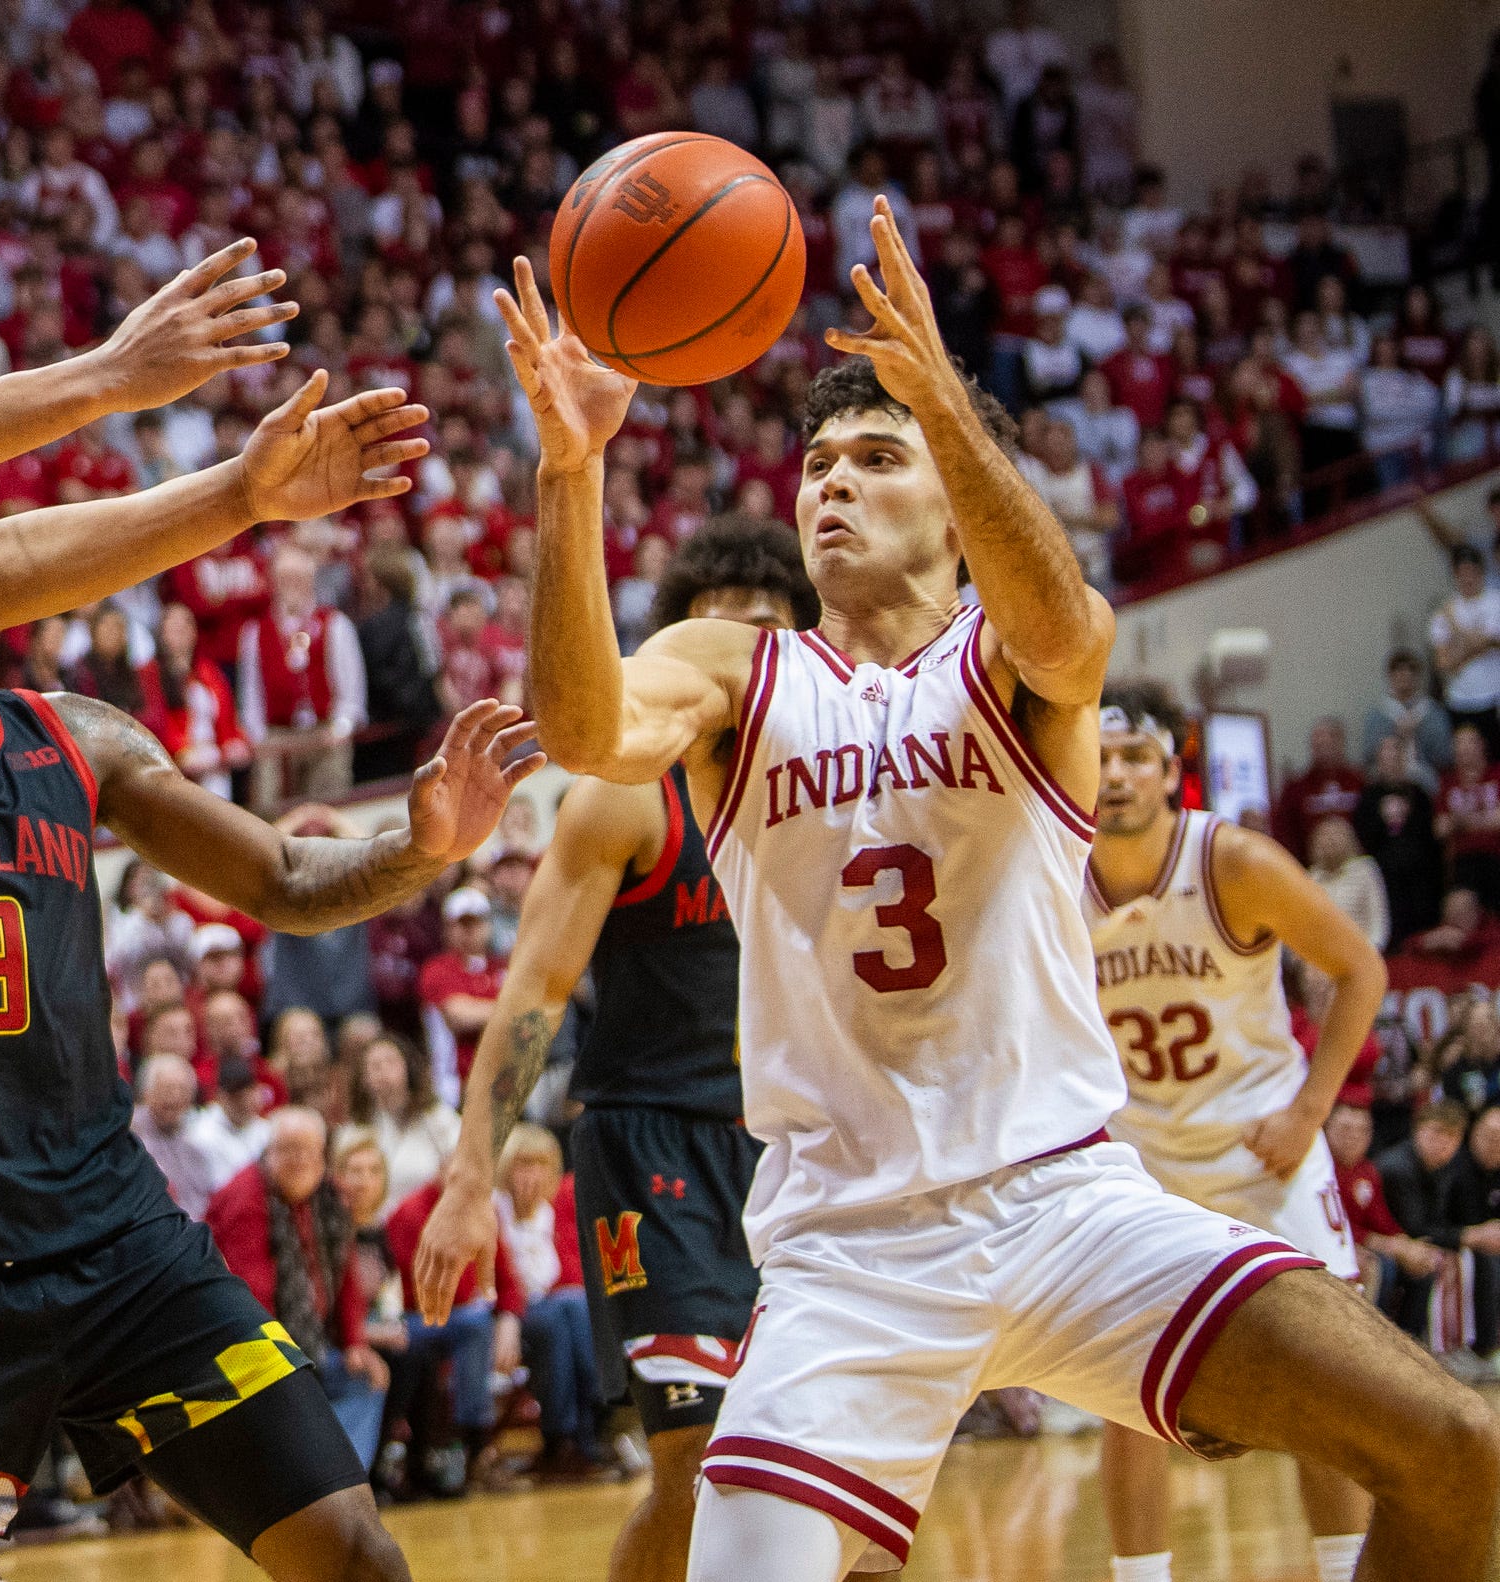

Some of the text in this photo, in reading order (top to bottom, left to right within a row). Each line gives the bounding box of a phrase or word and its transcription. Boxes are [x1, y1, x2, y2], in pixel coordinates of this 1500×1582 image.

[842, 843, 948, 994] 3
[1096, 943, 1224, 988] NDIANA
[1108, 1001, 1219, 1082] 32
[596, 1210, 646, 1287] M
